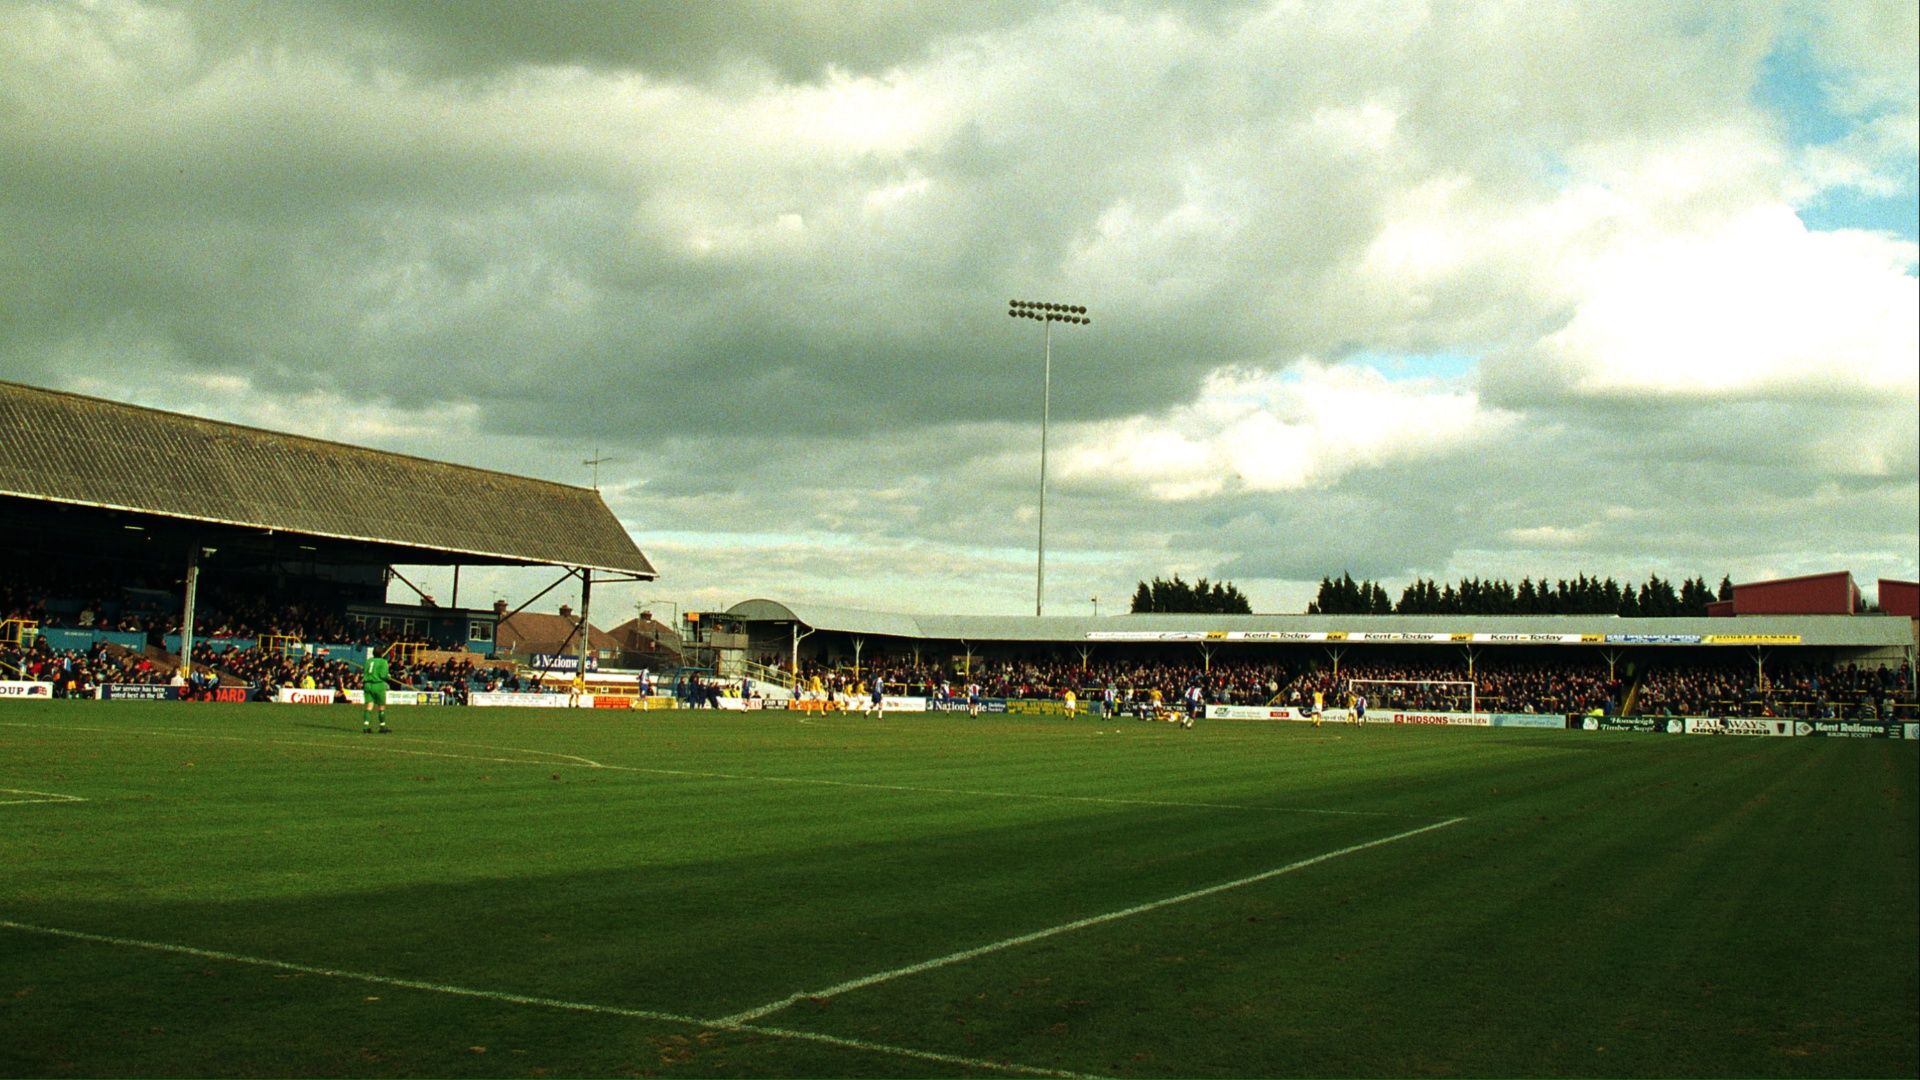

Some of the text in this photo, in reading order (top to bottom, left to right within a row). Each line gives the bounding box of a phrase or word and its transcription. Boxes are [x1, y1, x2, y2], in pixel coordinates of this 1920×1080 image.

[541, 654, 591, 669] Ntionwe
[291, 692, 330, 704] Canon
[935, 701, 987, 712] Nationwde
[1406, 714, 1449, 724] HIDSONS
[1696, 719, 1767, 729] FAIWAYS
[1815, 722, 1839, 731] Kent
[1840, 723, 1884, 733] Reliance
